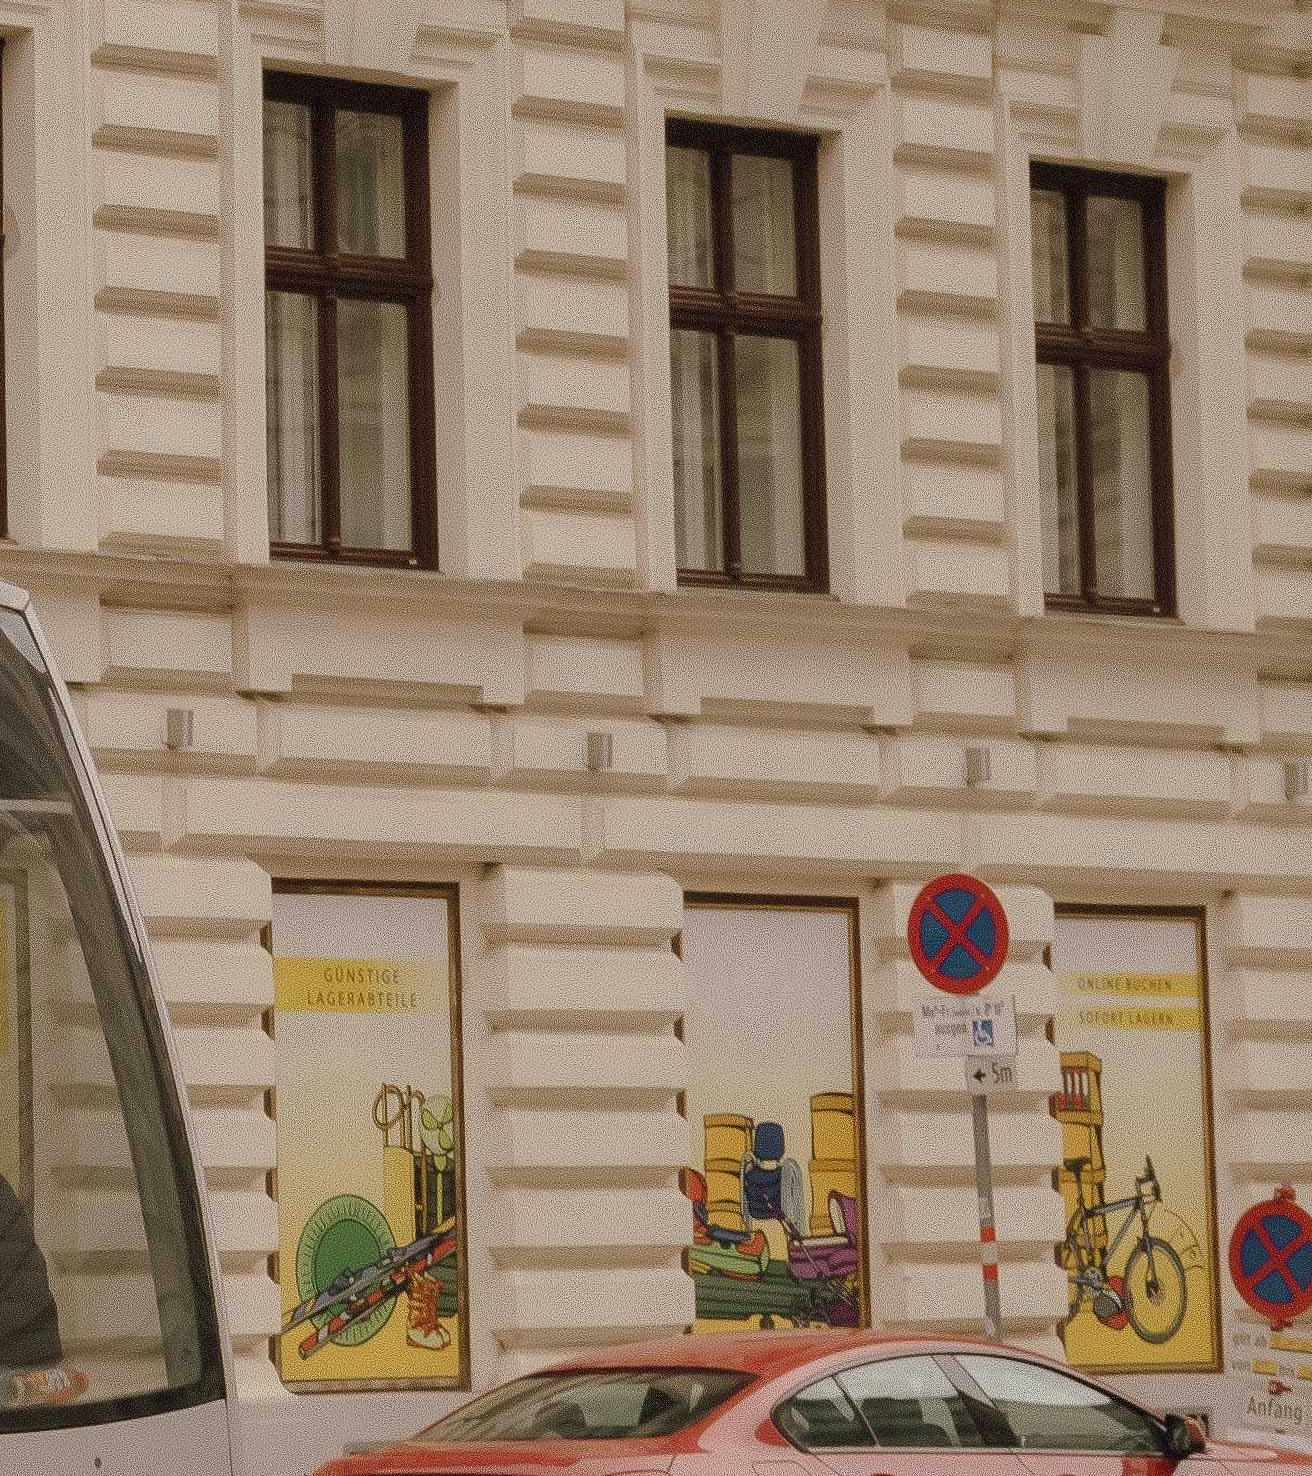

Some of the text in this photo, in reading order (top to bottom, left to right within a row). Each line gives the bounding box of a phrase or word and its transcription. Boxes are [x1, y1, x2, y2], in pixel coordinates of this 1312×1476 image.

[324, 966, 401, 984] GÜNSTIGE
[307, 991, 418, 1008] LAGERABTEILE
[991, 1062, 1013, 1084] 5m
[1246, 1397, 1304, 1425] Anfang
